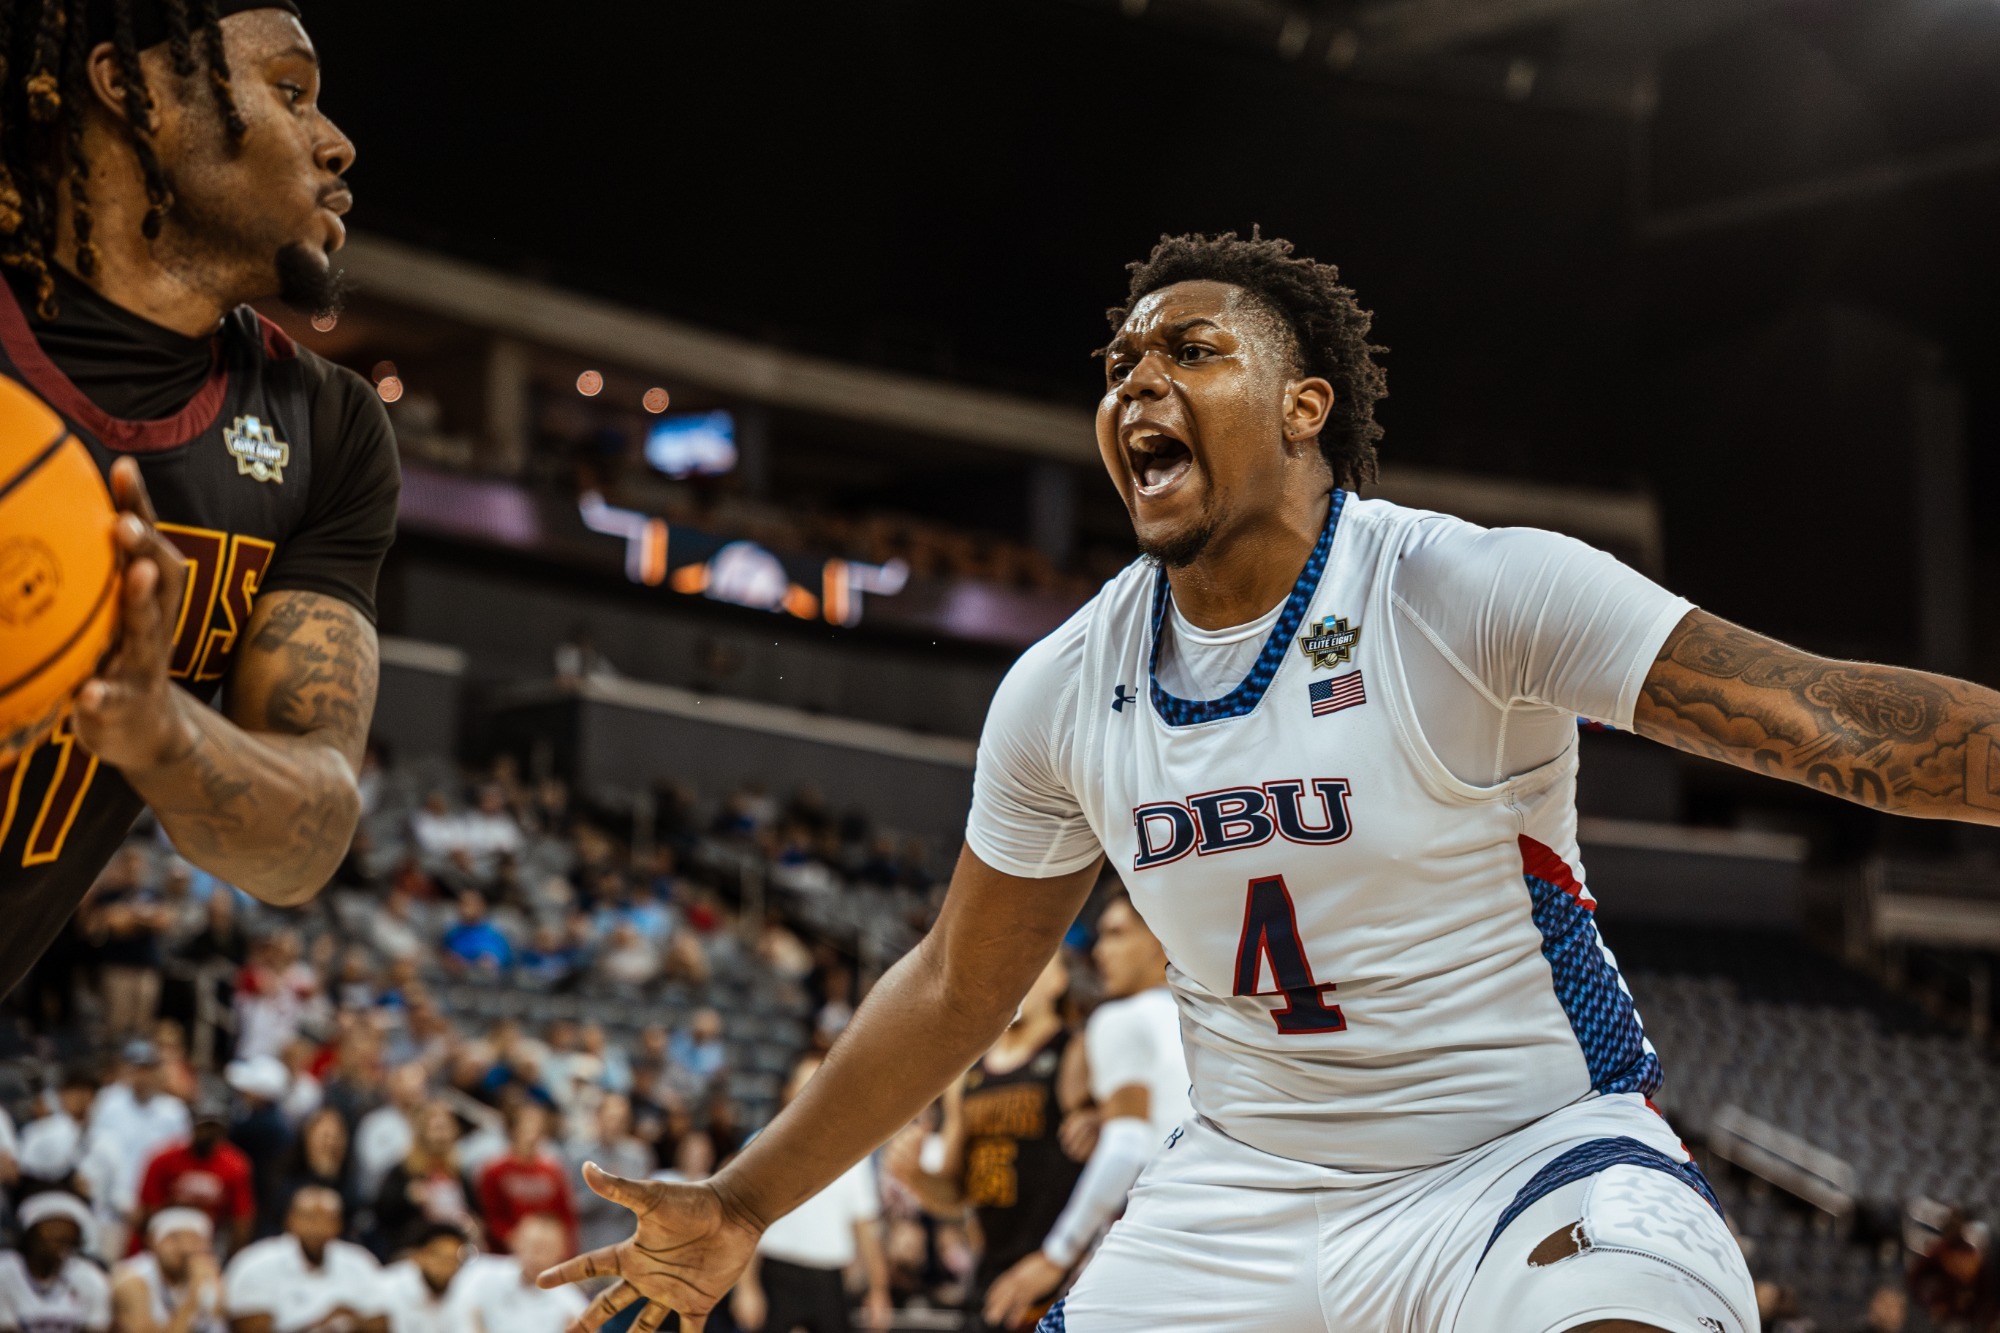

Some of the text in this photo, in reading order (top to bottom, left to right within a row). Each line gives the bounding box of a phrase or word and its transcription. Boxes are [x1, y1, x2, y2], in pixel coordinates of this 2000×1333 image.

[1309, 640, 1330, 650] ELITE
[1331, 634, 1354, 646] EIGHT
[1133, 778, 1353, 872] DBU
[1233, 874, 1347, 1035] 4
